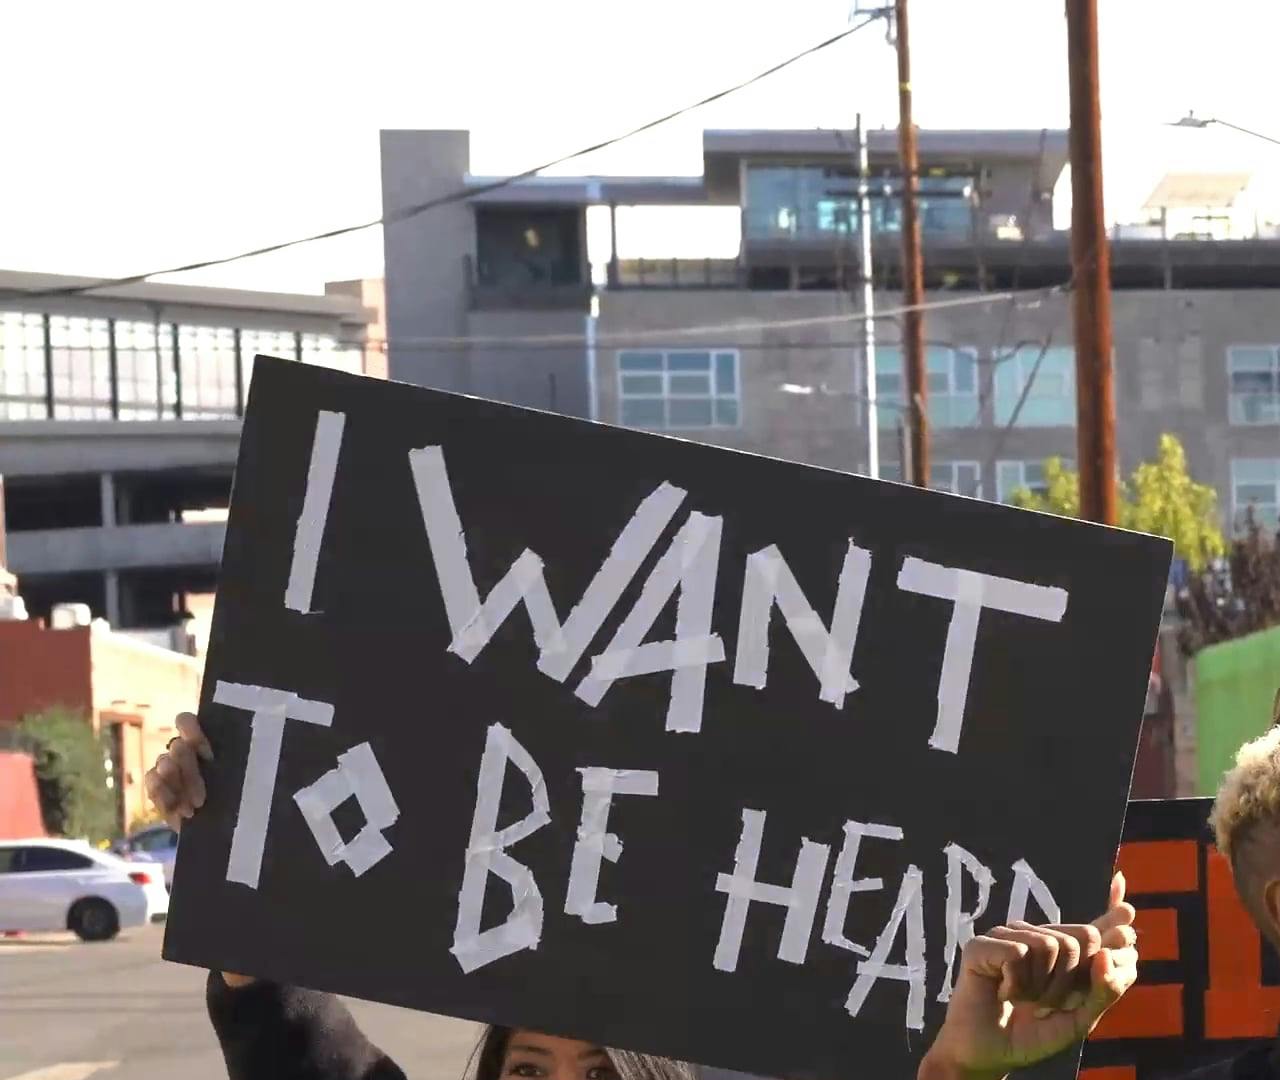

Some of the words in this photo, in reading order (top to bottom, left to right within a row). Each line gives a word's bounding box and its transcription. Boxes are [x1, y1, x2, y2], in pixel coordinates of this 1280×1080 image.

[284, 411, 345, 614] I
[408, 445, 1068, 754] WANT
[450, 722, 659, 974] BE
